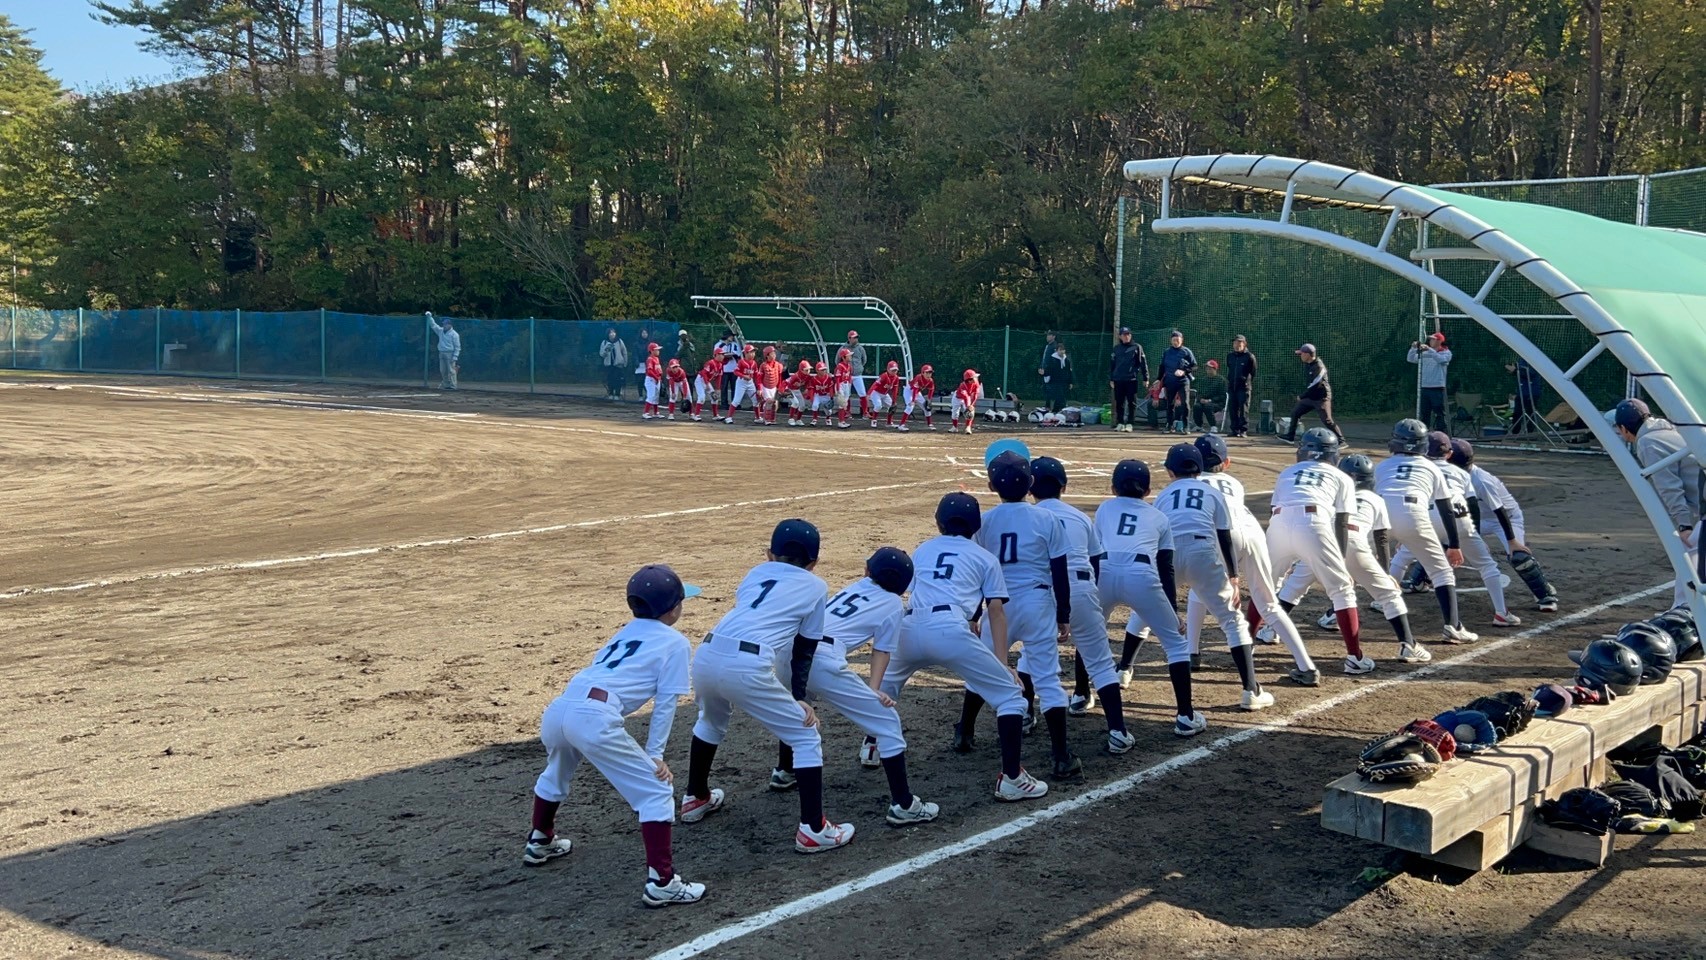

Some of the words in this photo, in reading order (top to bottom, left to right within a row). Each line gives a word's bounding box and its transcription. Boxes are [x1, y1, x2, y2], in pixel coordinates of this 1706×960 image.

[1395, 465, 1413, 480] 9
[1170, 488, 1204, 511] 18
[1202, 479, 1234, 496] 6
[1117, 513, 1138, 536] 6
[999, 532, 1018, 564] 0
[933, 552, 958, 580] 5
[751, 579, 778, 609] 1
[826, 591, 870, 618] 15
